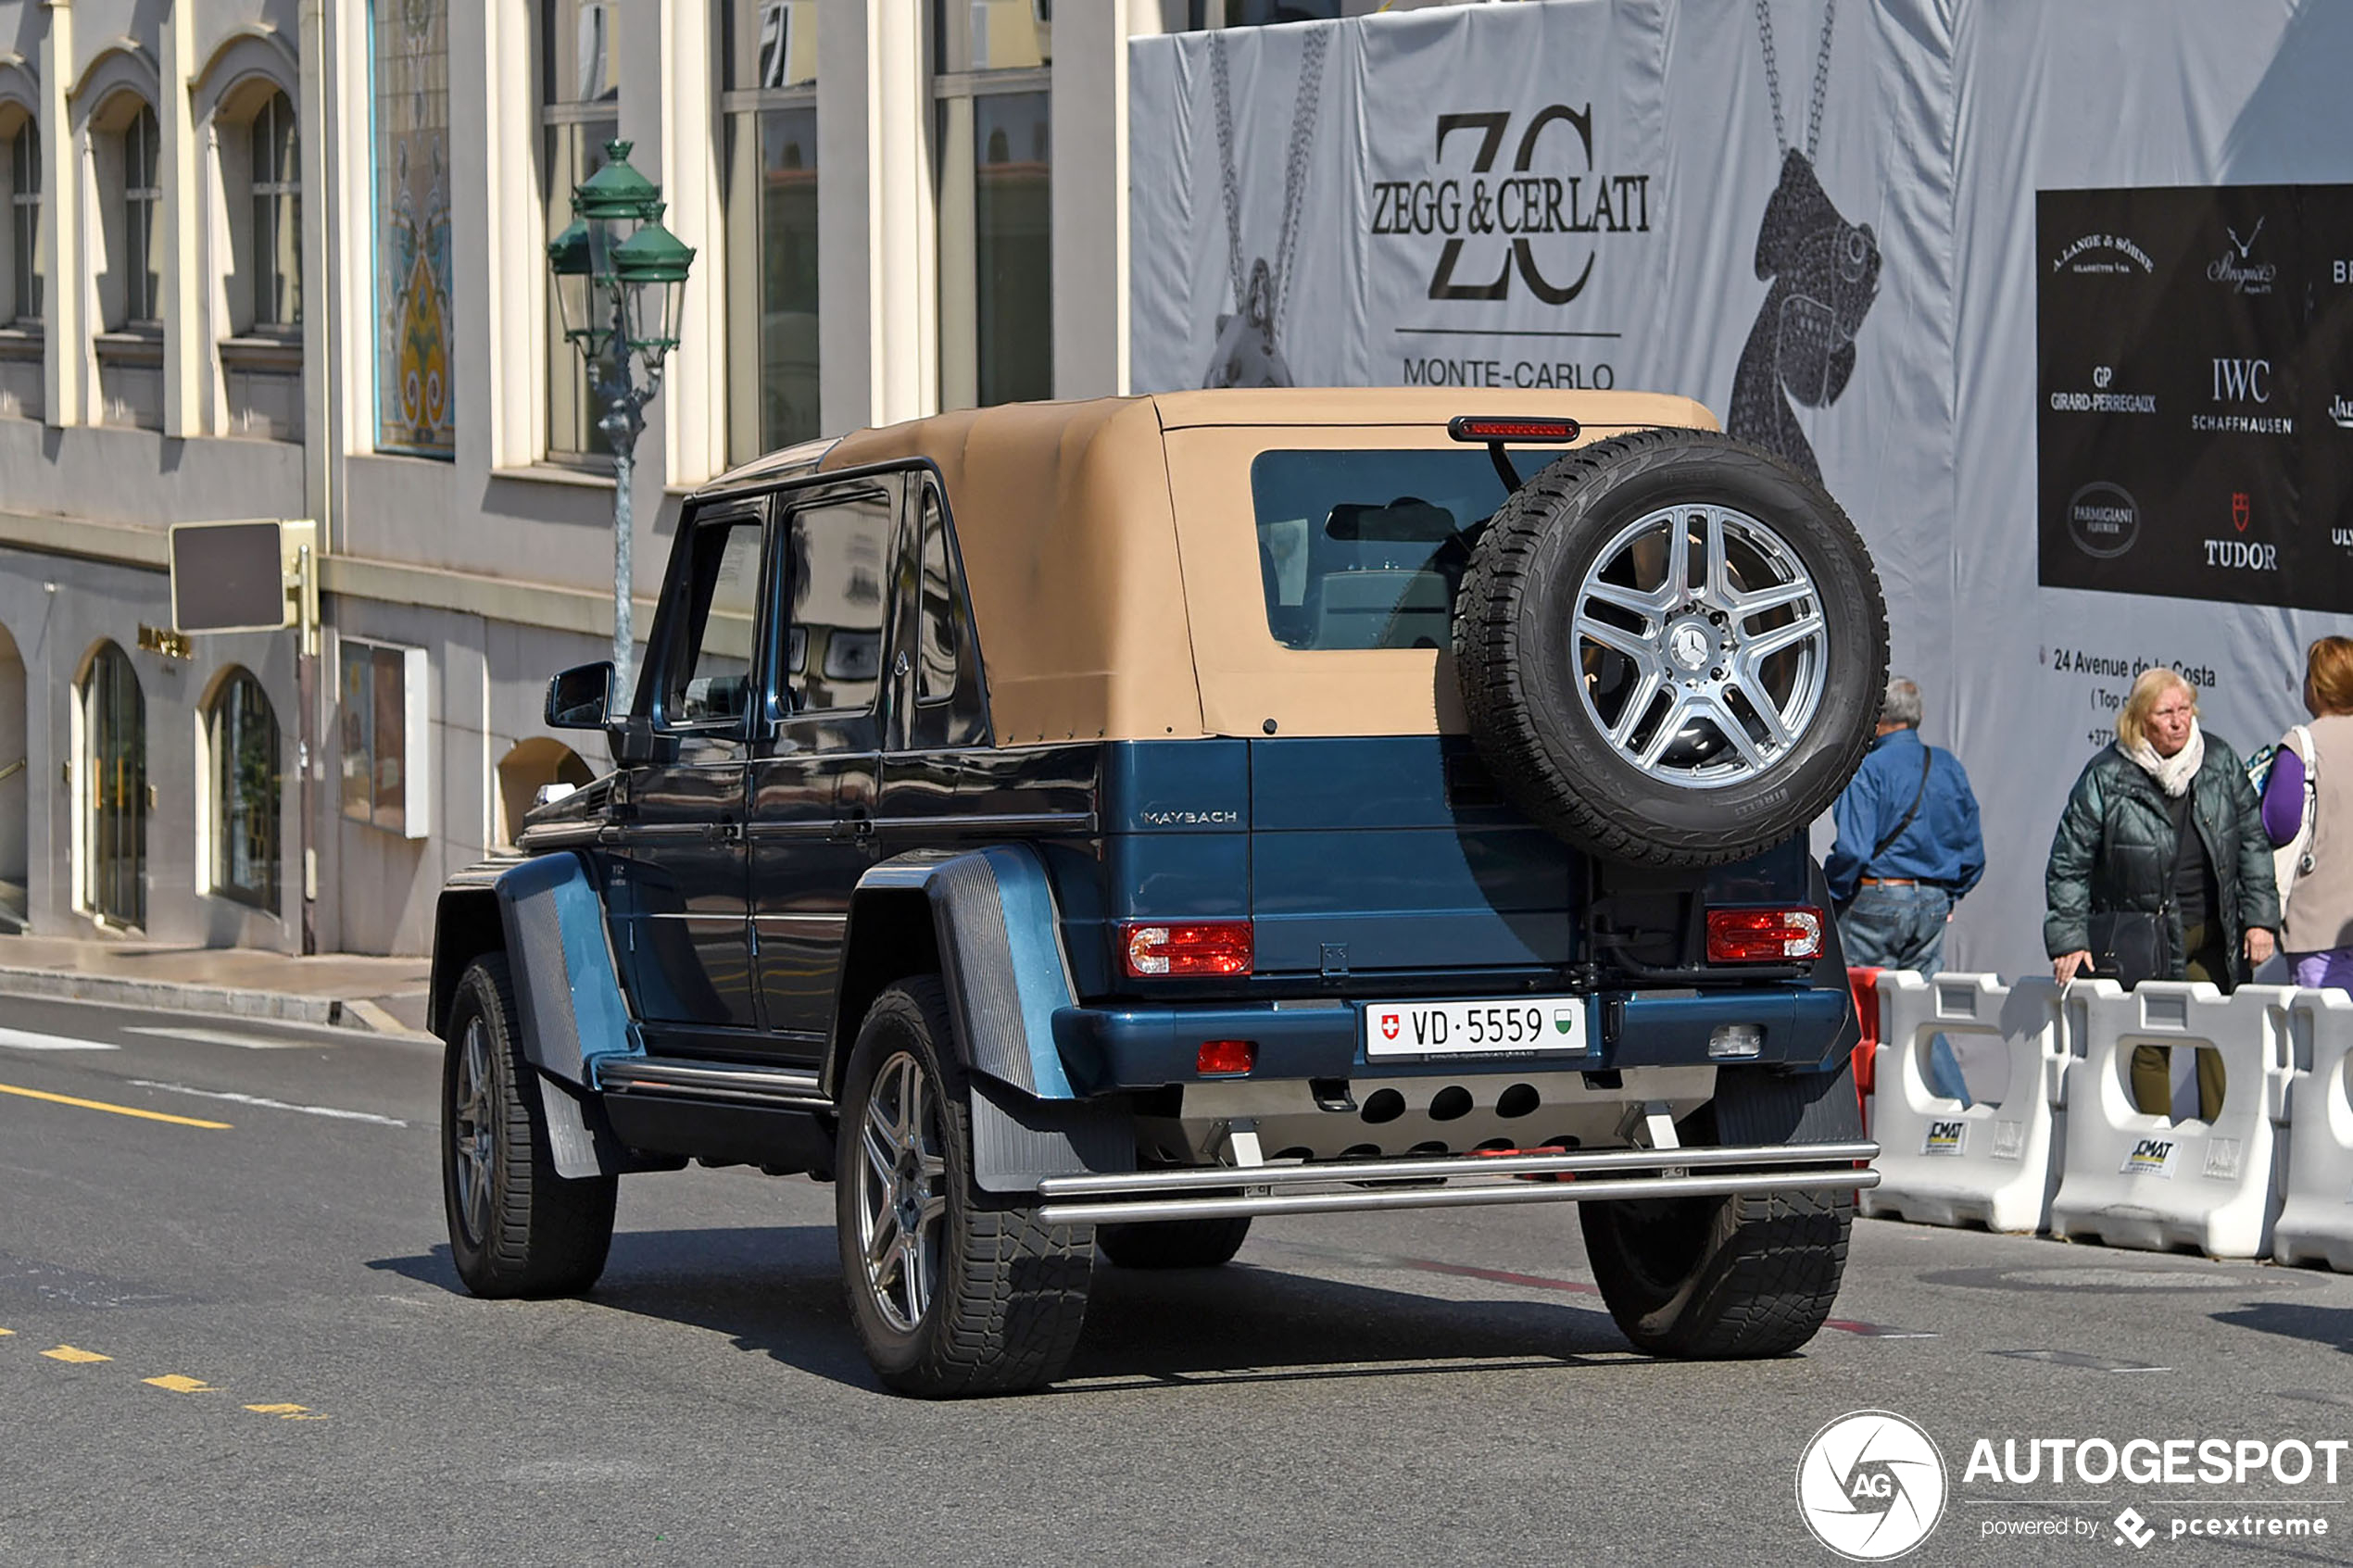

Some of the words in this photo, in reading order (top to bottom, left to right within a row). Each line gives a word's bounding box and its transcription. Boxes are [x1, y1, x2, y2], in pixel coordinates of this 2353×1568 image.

[1371, 181, 1462, 234] ZEGG
[1467, 179, 1495, 234] &
[1496, 174, 1651, 234] CERLATI
[2334, 260, 2353, 284] B
[1403, 358, 1615, 390] MONTE-CARLO
[2093, 367, 2112, 389] GP
[2212, 358, 2270, 404] IWC
[2050, 392, 2157, 413] GIRARD-PERREGAUX
[2192, 414, 2293, 434] SCHAFFHAUSEN
[2204, 539, 2278, 571] TUDOR
[2054, 648, 2071, 671] 24
[2074, 651, 2129, 678] Avenue
[2097, 689, 2120, 713] Top
[1144, 811, 1237, 824] MAYBACH
